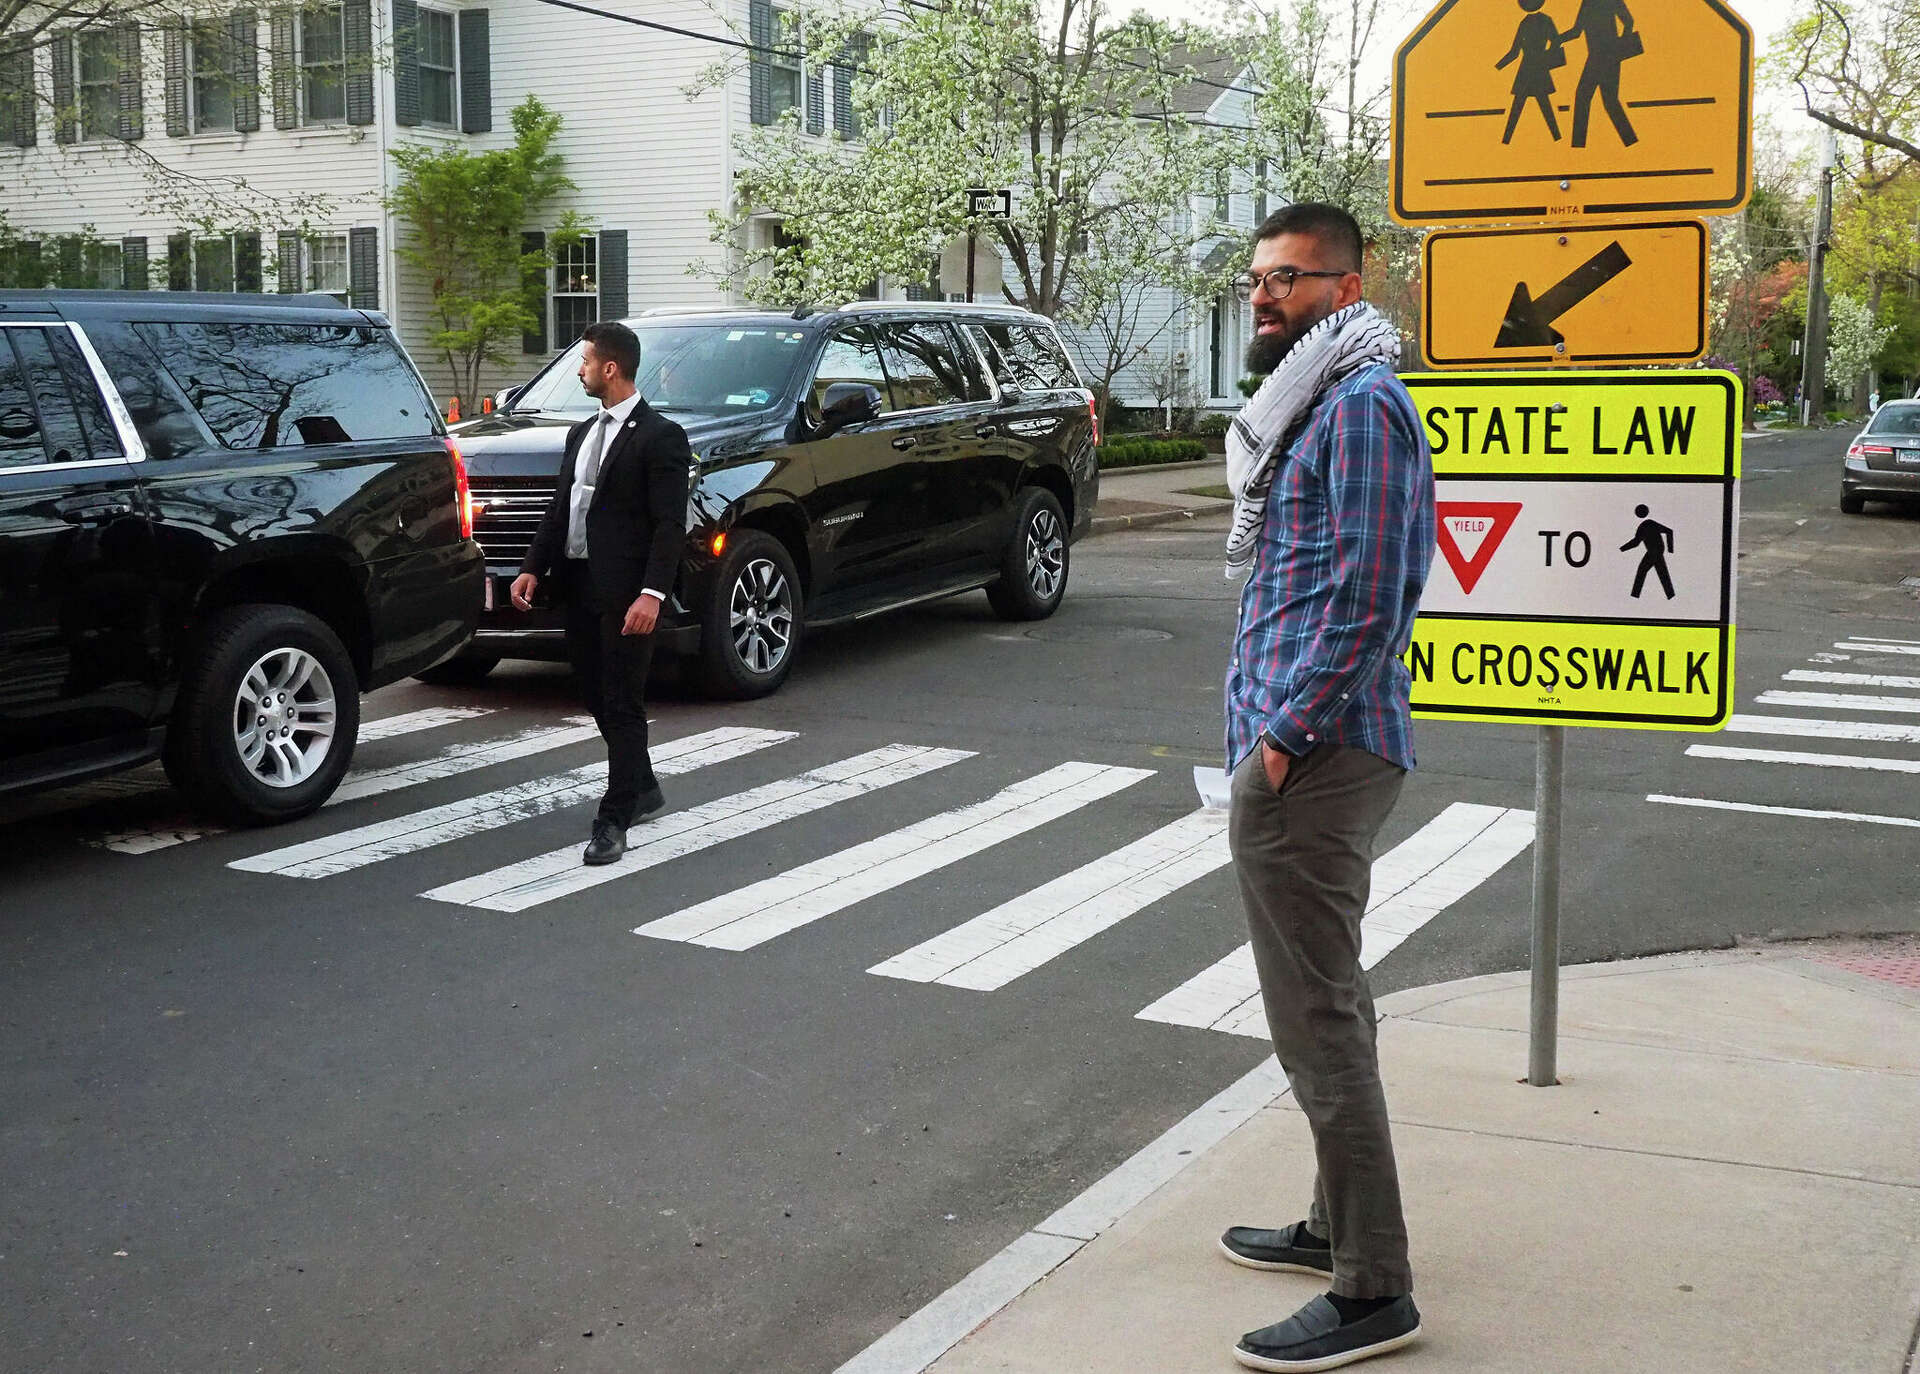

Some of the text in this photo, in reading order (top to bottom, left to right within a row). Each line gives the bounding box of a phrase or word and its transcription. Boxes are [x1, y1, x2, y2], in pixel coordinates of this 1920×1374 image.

[1550, 206, 1580, 215] NHTA
[1426, 406, 1696, 455] STATE LAW
[1454, 520, 1485, 533] YIELD
[1538, 530, 1592, 568] TO
[1404, 641, 1711, 695] N CROSSWALK
[1537, 696, 1562, 705] NHTA
